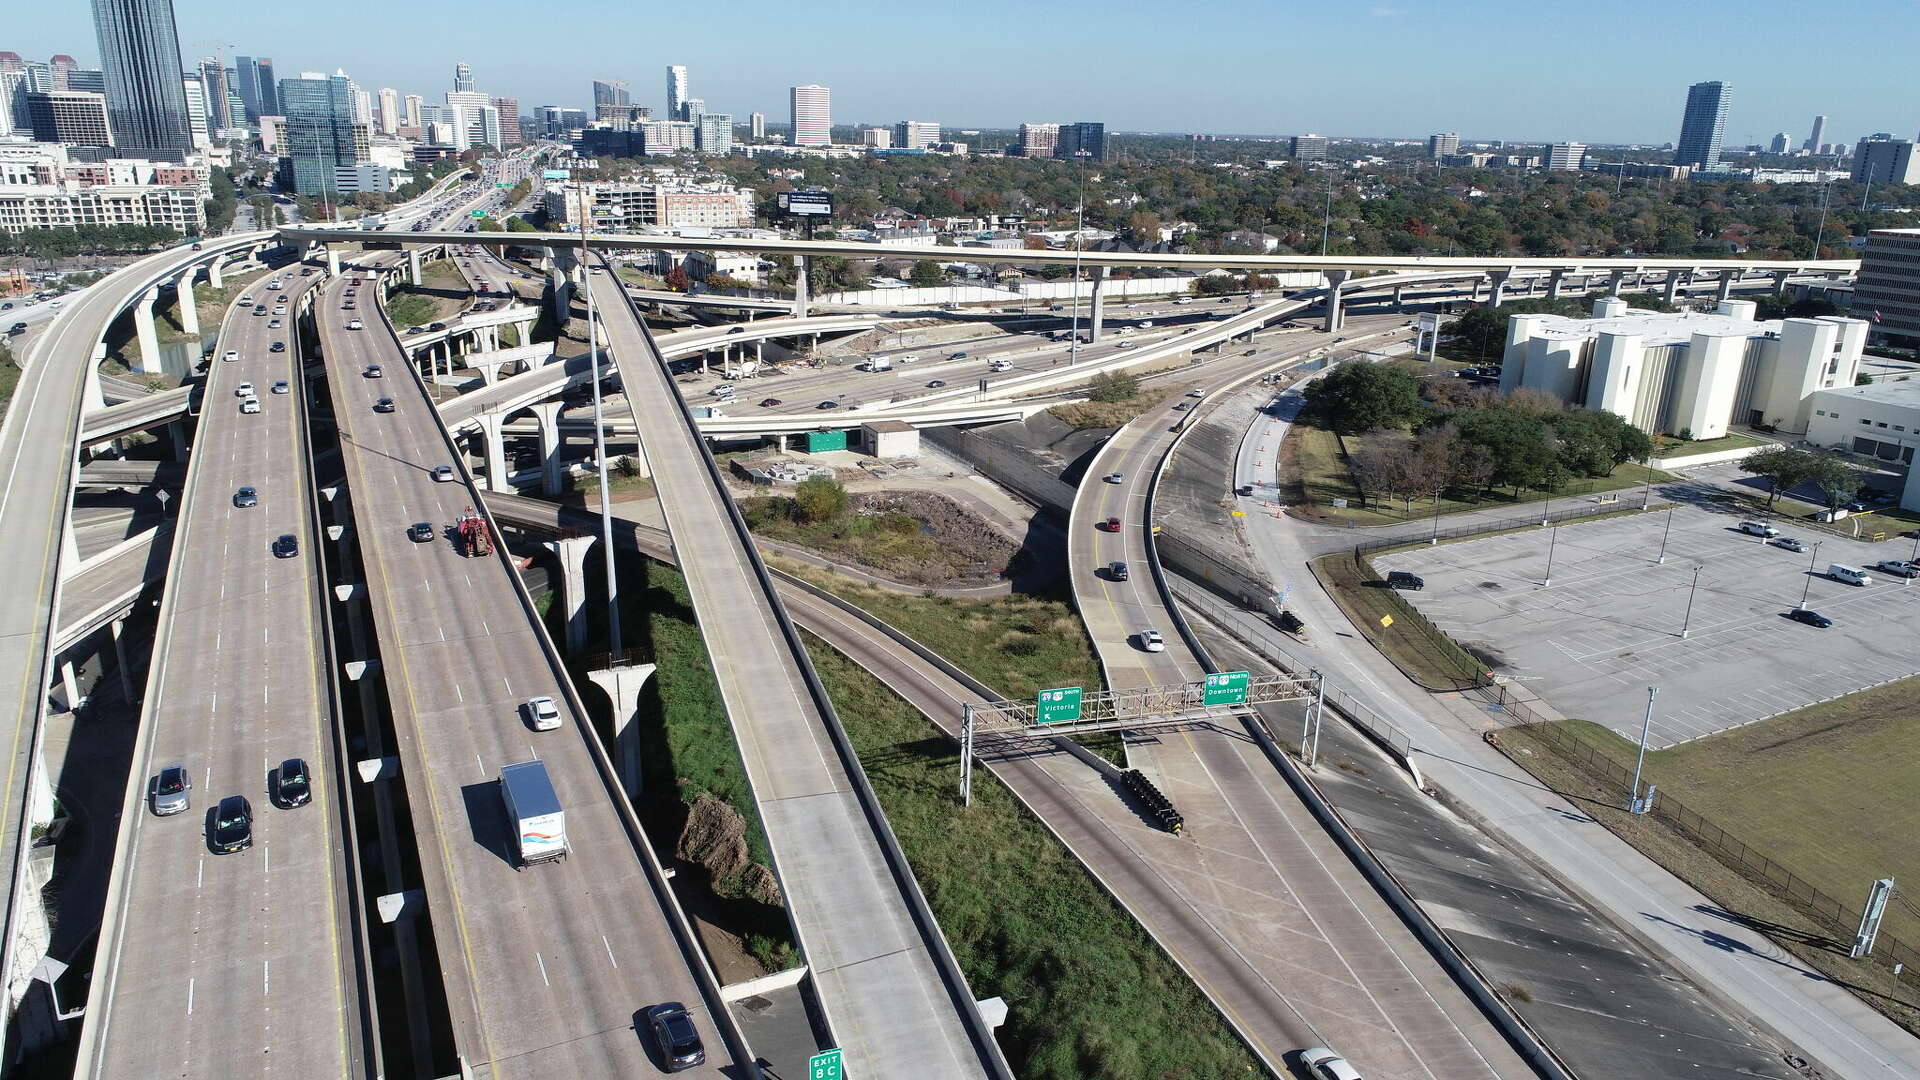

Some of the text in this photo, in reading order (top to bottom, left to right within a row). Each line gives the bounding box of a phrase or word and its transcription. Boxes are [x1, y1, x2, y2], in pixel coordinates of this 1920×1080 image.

[1208, 687, 1243, 696] Downtown
[1044, 704, 1075, 712] Victoria
[814, 1055, 838, 1067] EXIT
